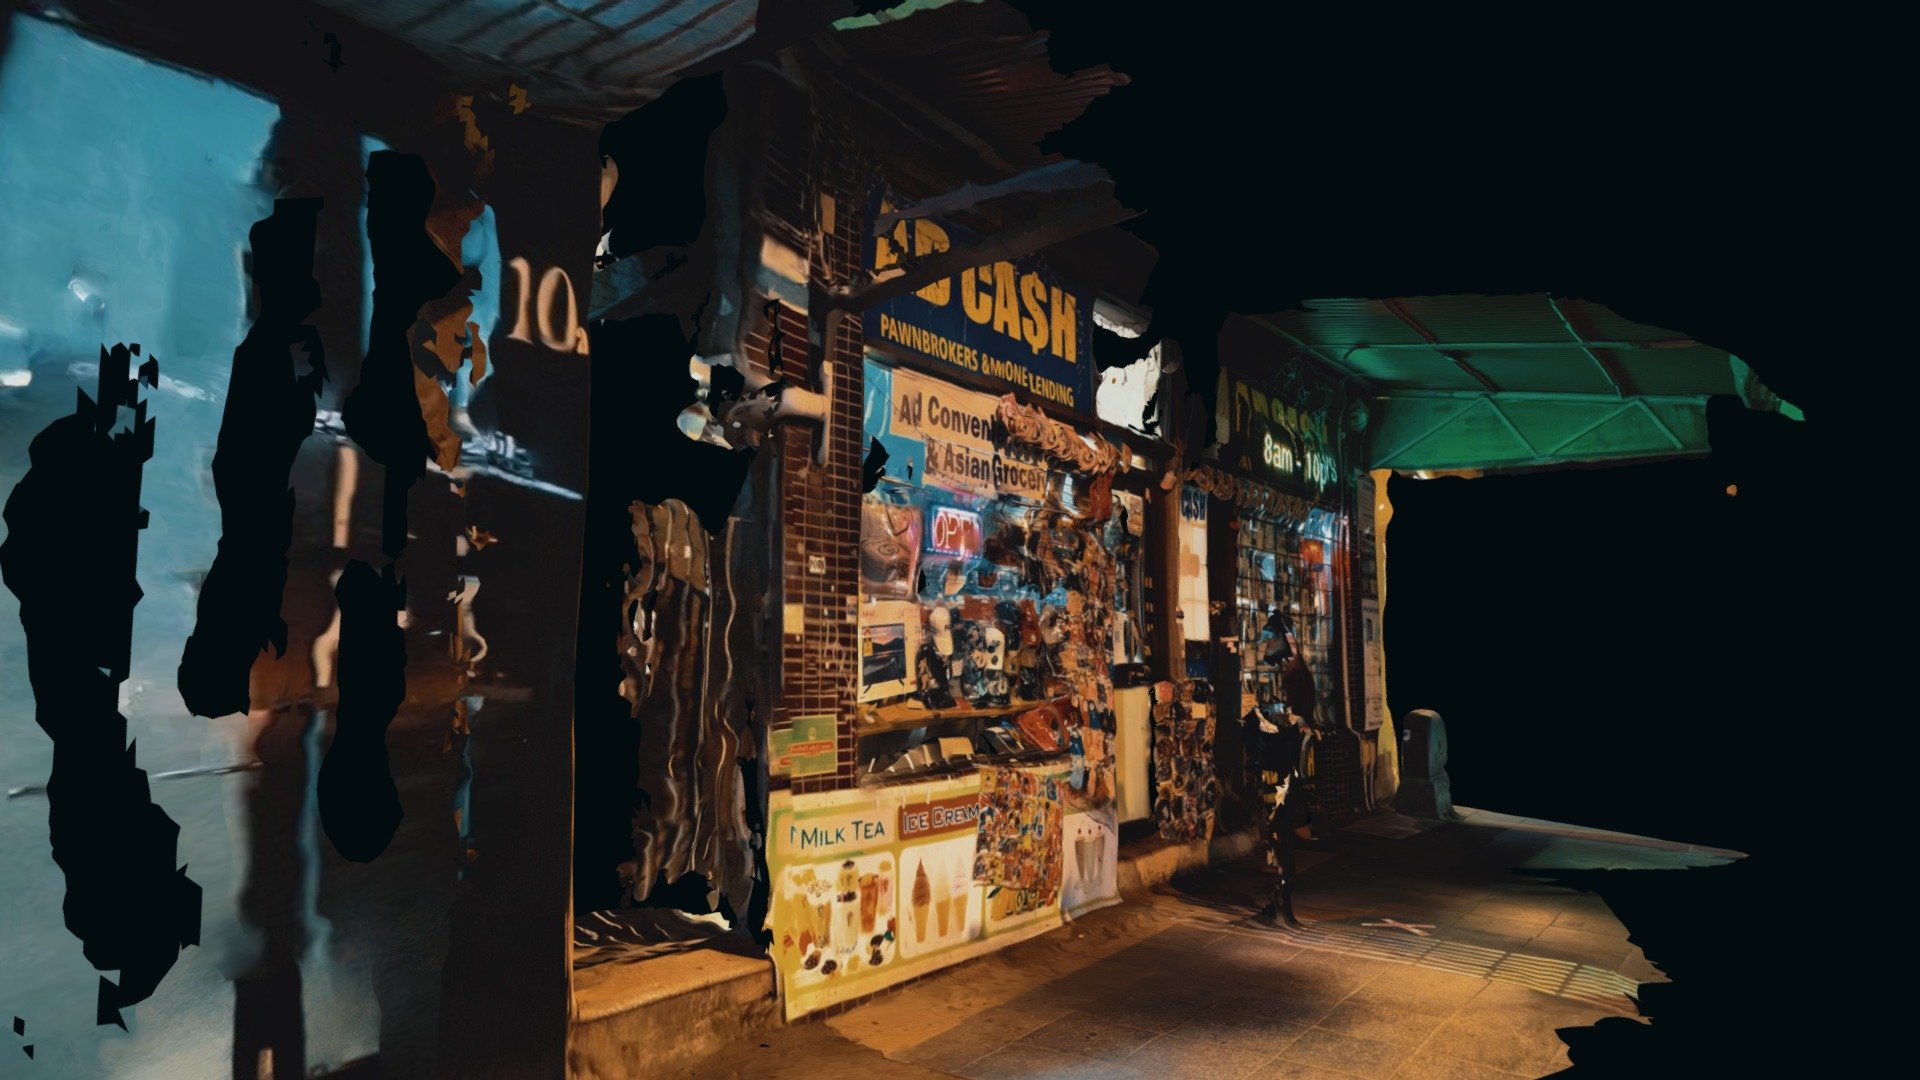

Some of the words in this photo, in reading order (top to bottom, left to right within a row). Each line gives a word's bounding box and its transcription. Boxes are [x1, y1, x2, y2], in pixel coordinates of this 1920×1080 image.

[961, 260, 1077, 364] CA$H
[880, 312, 979, 372] PAWNBROKERS
[1030, 373, 1075, 408] LENDING
[899, 392, 922, 426] Ad
[943, 442, 990, 481] Asian
[1263, 431, 1294, 475] 8am
[801, 826, 846, 850] MILK
[851, 820, 886, 841] TEA
[903, 811, 930, 834] ICE
